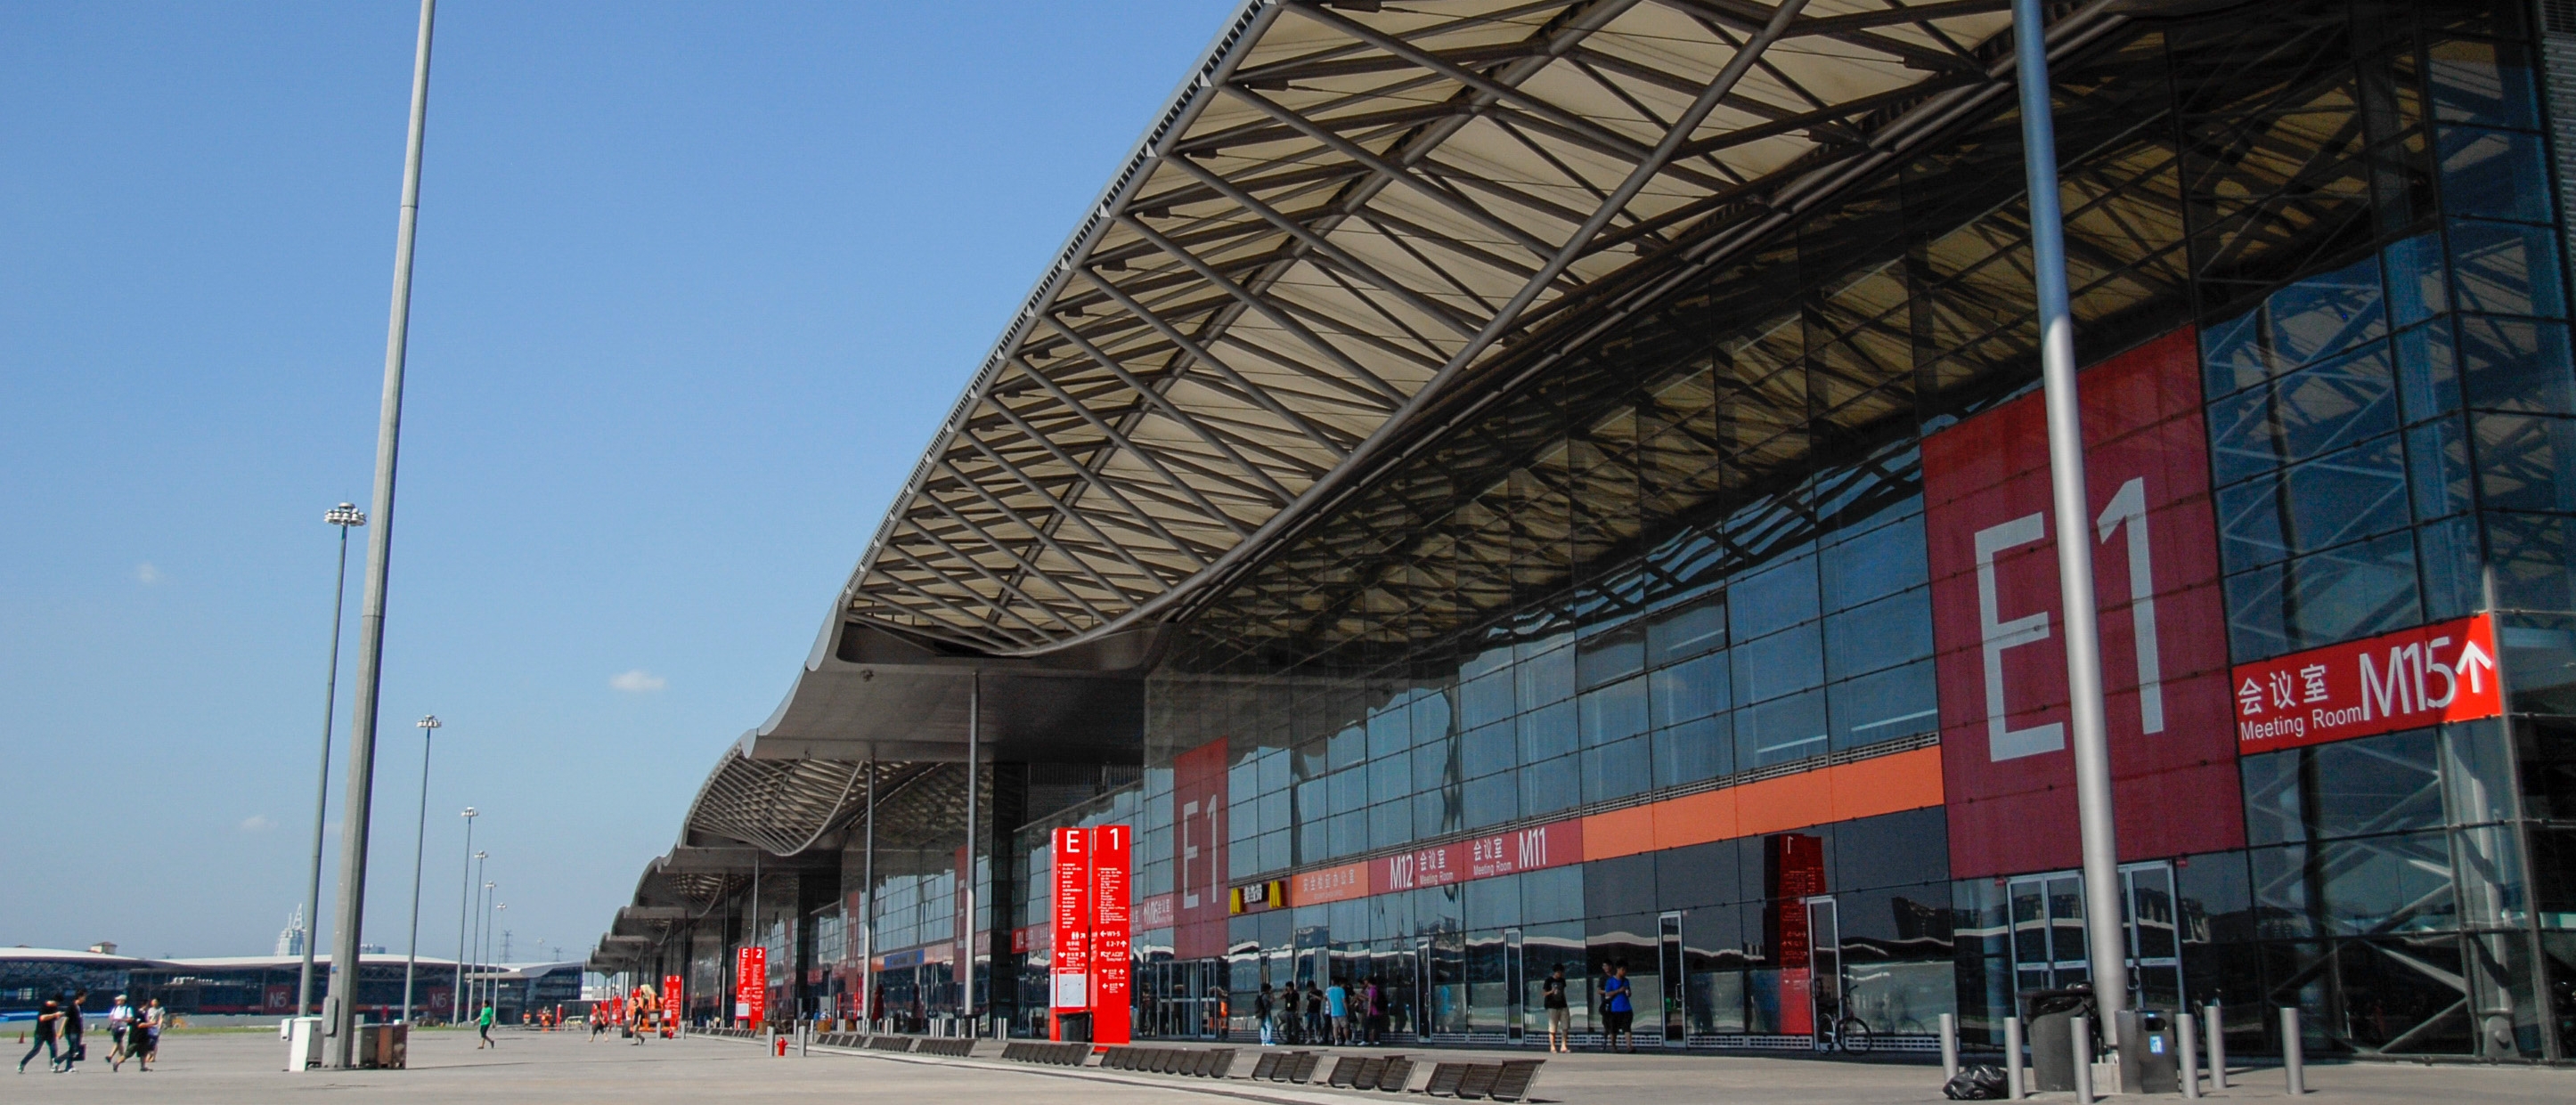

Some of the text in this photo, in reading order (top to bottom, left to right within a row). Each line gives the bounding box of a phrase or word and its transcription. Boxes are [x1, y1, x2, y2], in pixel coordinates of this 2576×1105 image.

[1975, 477, 2164, 763] E1
[2238, 663, 2328, 715] 会议室
[2359, 636, 2456, 721] M15
[2240, 706, 2361, 741] Meeting Room
[1066, 827, 1119, 853] E 1
[1183, 794, 1217, 909] E1
[1473, 837, 1503, 861] 会议室
[1519, 827, 1546, 869] M11
[1390, 854, 1414, 890] M12
[1420, 849, 1446, 871] 会议室
[1473, 861, 1512, 876] Meeting Room
[1420, 871, 1454, 886] Meeting Room
[742, 948, 762, 959] E 2
[269, 991, 287, 1008] N5
[431, 992, 447, 1008] N5
